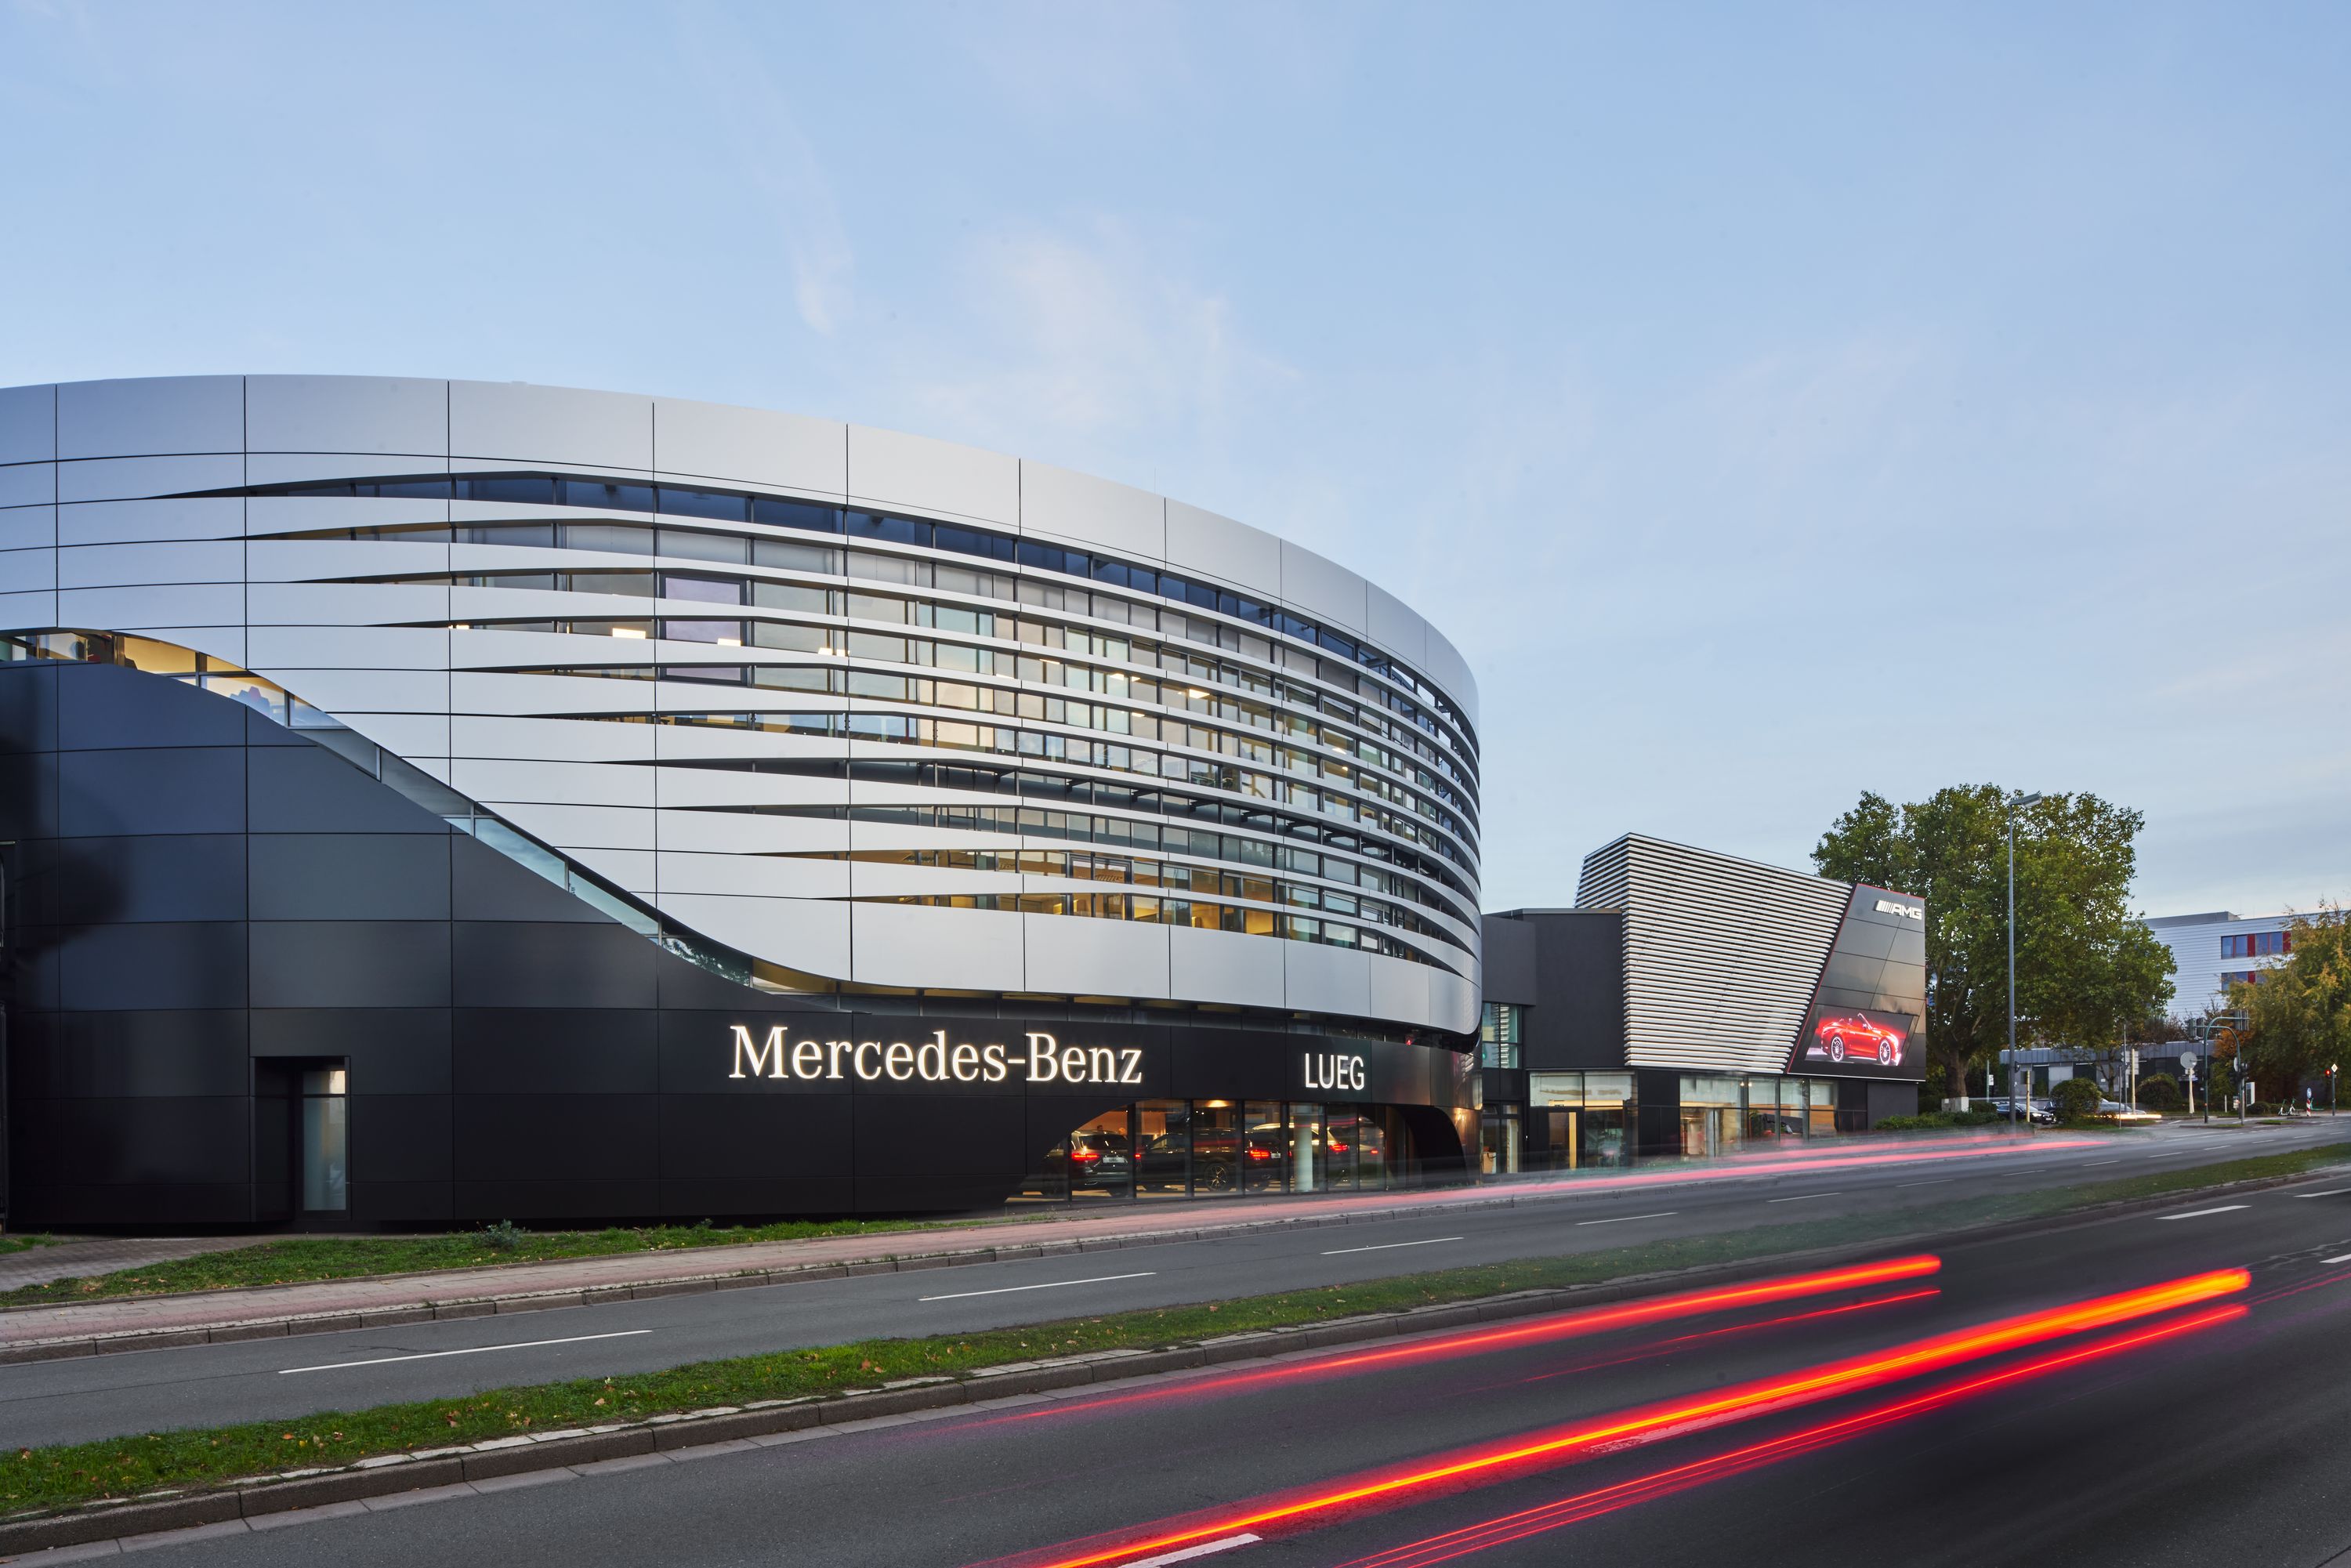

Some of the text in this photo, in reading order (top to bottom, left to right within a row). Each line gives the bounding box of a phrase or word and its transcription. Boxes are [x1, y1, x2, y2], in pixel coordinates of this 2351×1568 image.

[1891, 903, 1922, 920] AMG
[729, 1025, 1142, 1083] Mercedes-Benz
[1305, 1053, 1364, 1090] LUEG
